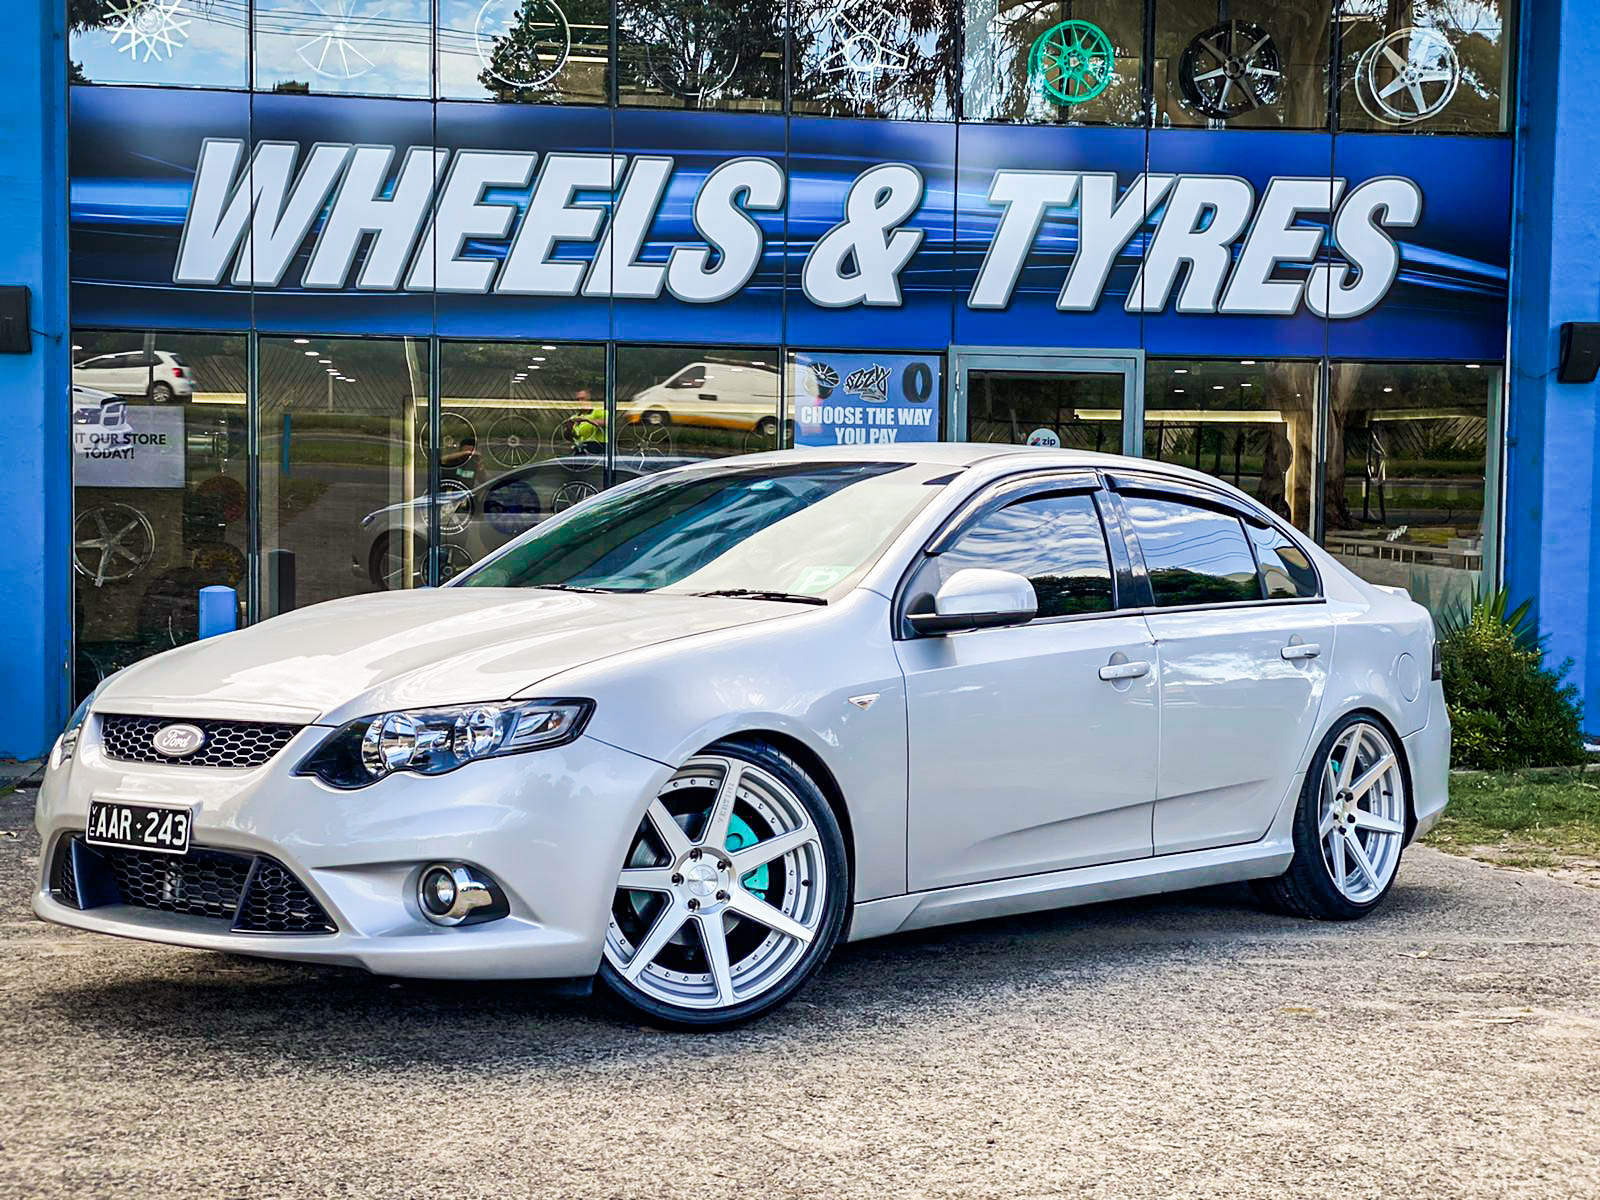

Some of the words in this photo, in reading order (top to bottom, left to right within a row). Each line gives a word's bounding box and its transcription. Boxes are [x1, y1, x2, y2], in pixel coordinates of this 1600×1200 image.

[173, 137, 786, 303] WHEELS
[802, 162, 924, 308] &
[966, 170, 1422, 319] TYRES
[801, 406, 863, 424] CHOOSE
[866, 407, 895, 425] THE
[897, 408, 933, 425] WAY
[89, 433, 120, 444] OUR
[123, 433, 166, 445] STORE
[835, 427, 866, 444] YOU
[870, 428, 898, 444] PAY
[1042, 437, 1056, 447] zip
[83, 447, 135, 459] TODAY!
[162, 729, 192, 748] Ford
